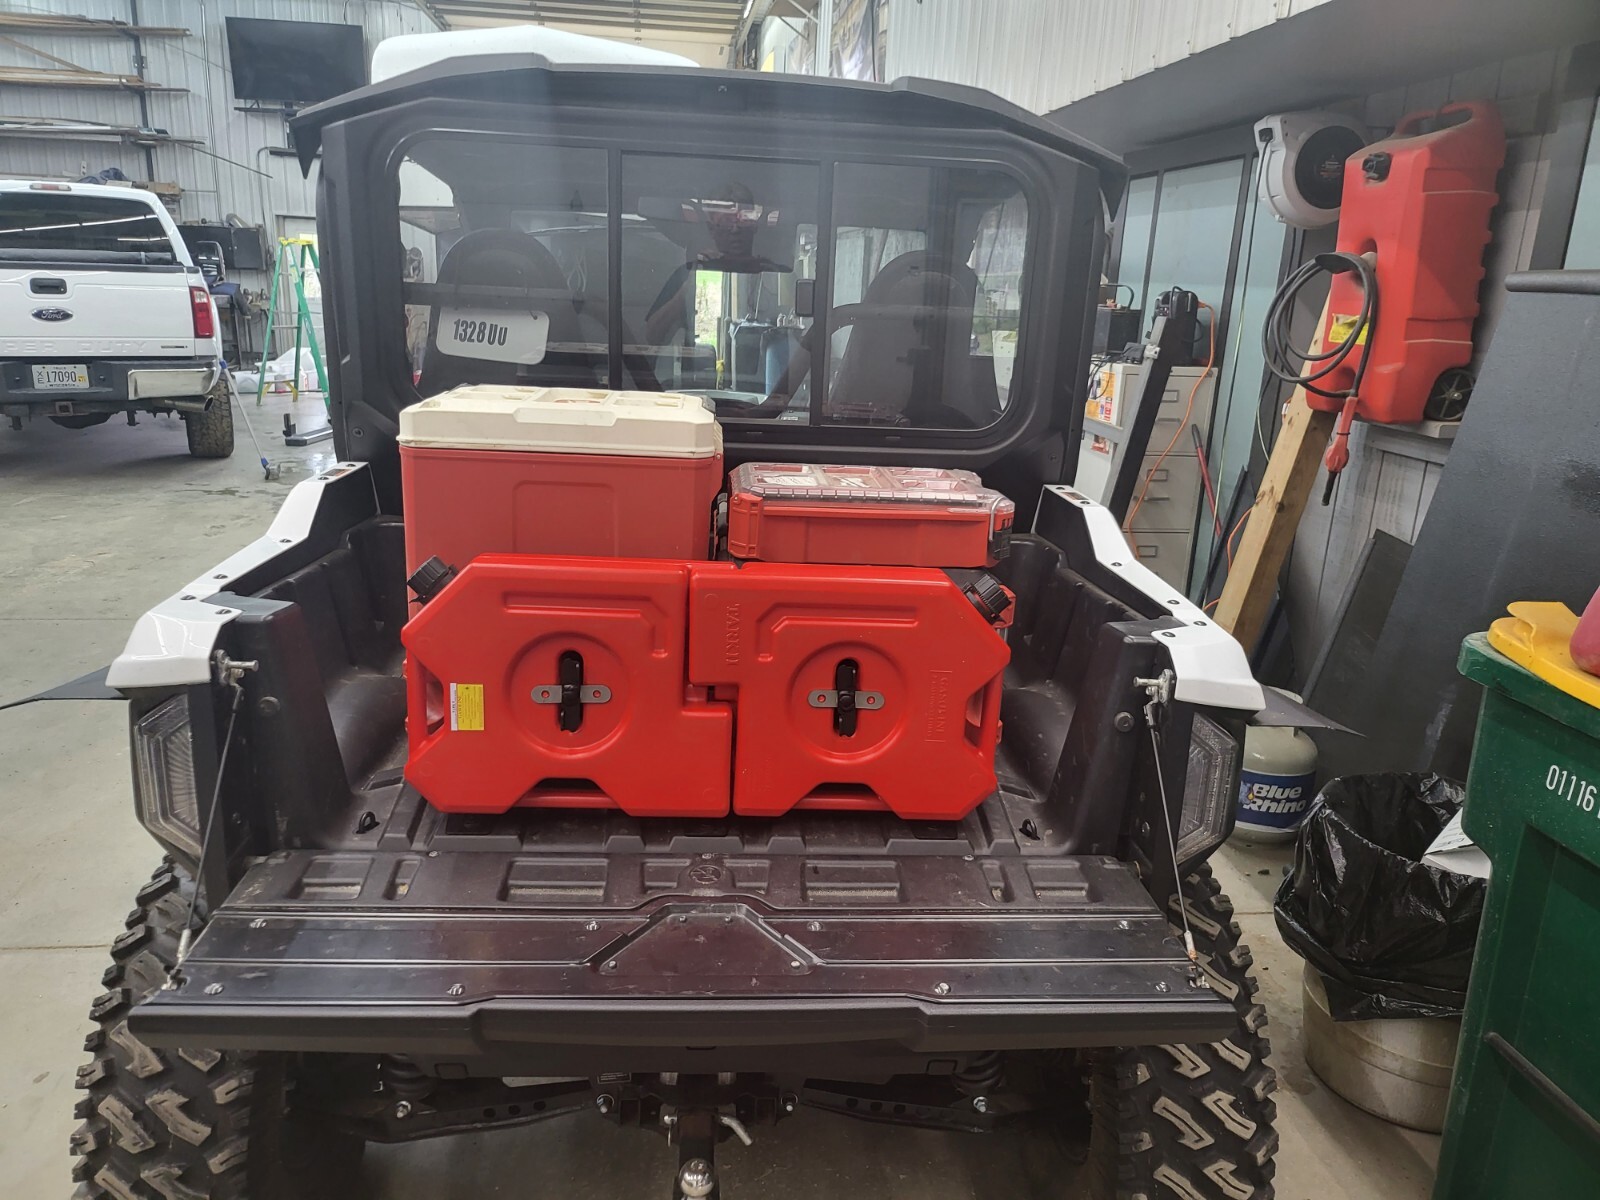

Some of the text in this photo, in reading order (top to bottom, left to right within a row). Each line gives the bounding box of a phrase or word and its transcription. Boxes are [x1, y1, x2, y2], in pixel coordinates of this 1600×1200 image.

[41, 310, 64, 319] Ford
[46, 370, 77, 383] 17090
[1253, 783, 1302, 799] Blue
[1546, 765, 1600, 819] 01116
[1243, 797, 1307, 813] Rhino
